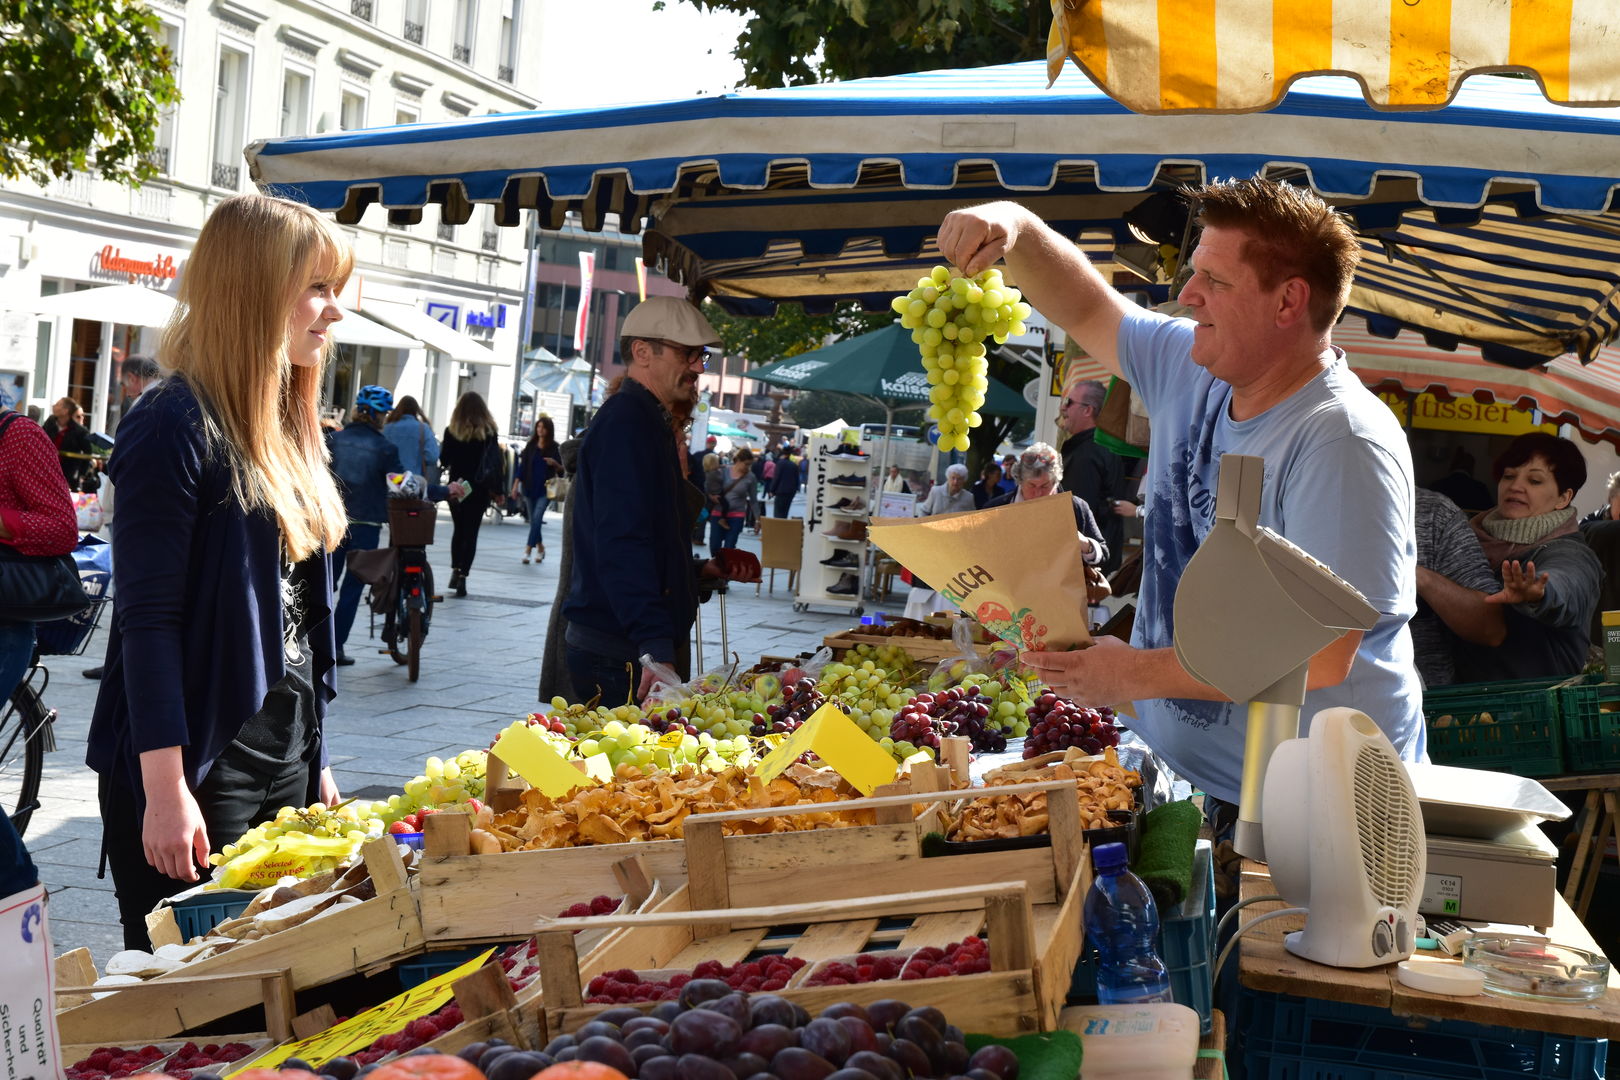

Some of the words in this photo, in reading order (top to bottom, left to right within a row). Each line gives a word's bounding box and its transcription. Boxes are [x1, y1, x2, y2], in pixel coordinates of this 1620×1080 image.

[881, 378, 930, 396] kaise
[808, 444, 828, 533] tamaris
[263, 859, 293, 869] Selected
[1445, 901, 1456, 911] M
[18, 1024, 29, 1054] und
[33, 998, 47, 1066] Qualität
